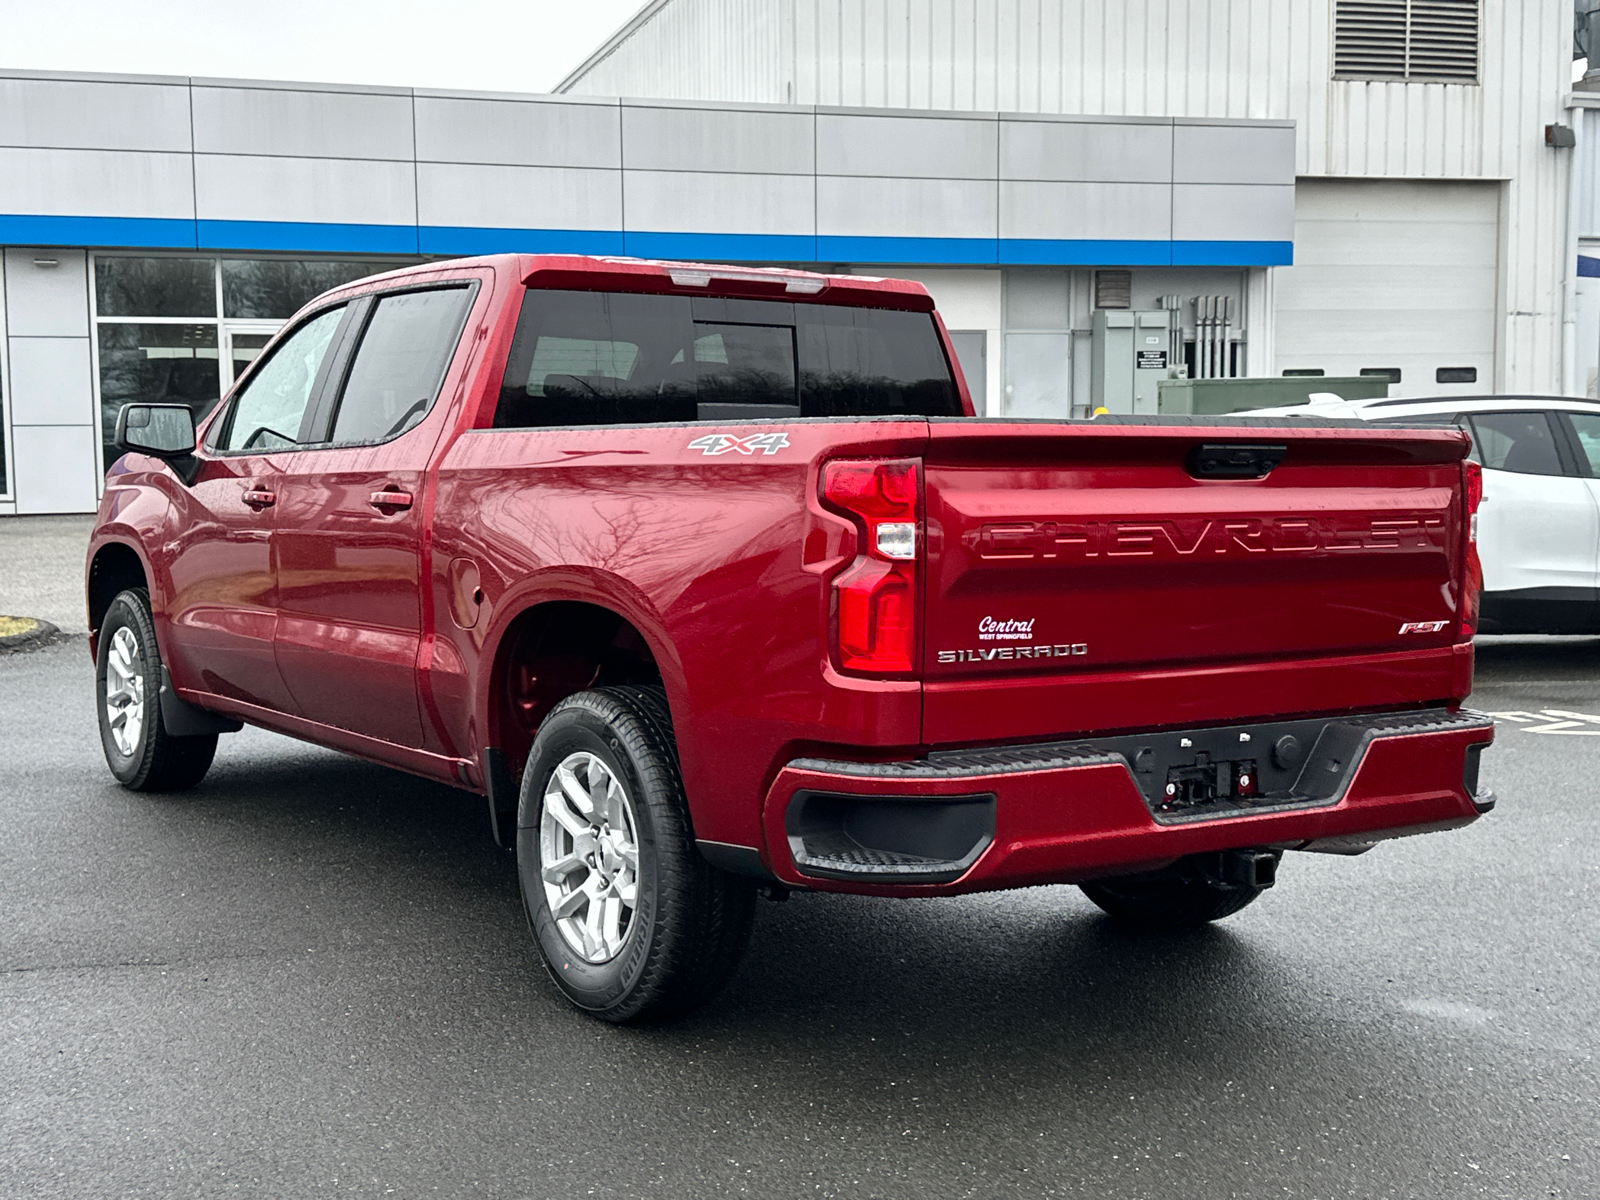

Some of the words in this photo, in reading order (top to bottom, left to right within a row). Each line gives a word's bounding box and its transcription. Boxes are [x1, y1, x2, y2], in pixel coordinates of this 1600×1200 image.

[981, 516, 1441, 559] CHEVROLET
[978, 616, 1035, 632] Central
[1398, 620, 1450, 634] RST
[937, 643, 1088, 663] SILVERADO
[621, 898, 651, 986] MICHELIN
